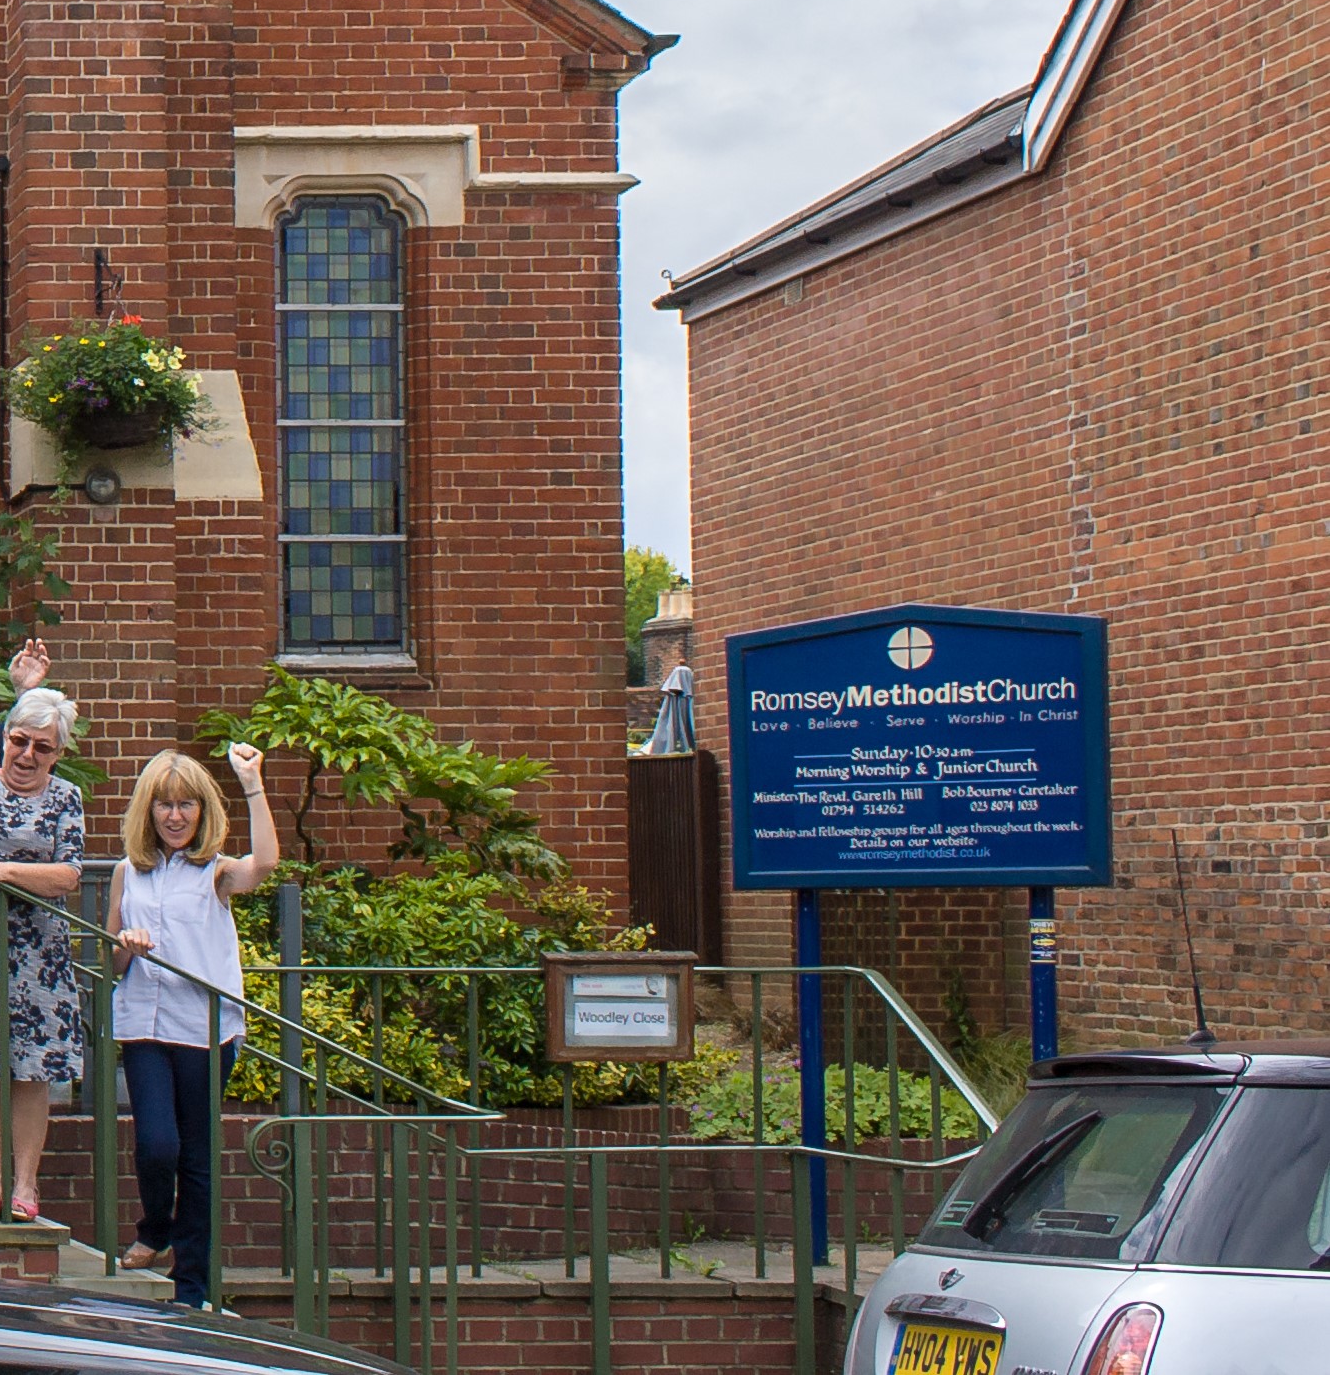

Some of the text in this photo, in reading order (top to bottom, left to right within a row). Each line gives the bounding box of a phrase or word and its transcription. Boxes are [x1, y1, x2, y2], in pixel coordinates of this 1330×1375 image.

[751, 709, 1079, 732] Love Believe Serve Worship In Christ
[850, 745, 909, 762] Sunday
[795, 758, 1039, 781] Morning Worship & Junior Church
[797, 791, 819, 804] The
[852, 788, 896, 802] Gareth
[901, 787, 923, 801] Hill
[942, 783, 1080, 798] Bob Bourne Caretaker
[862, 803, 906, 815] 514262
[753, 828, 797, 839] Worship
[797, 826, 816, 838] and
[909, 824, 927, 835] for
[927, 823, 943, 835] all
[945, 825, 969, 837] ages
[970, 822, 1033, 835] throughout
[1033, 820, 1050, 832] the
[849, 837, 887, 849] Details
[888, 838, 904, 848] on
[907, 837, 930, 848] our
[578, 1011, 665, 1025] Woodley Close
